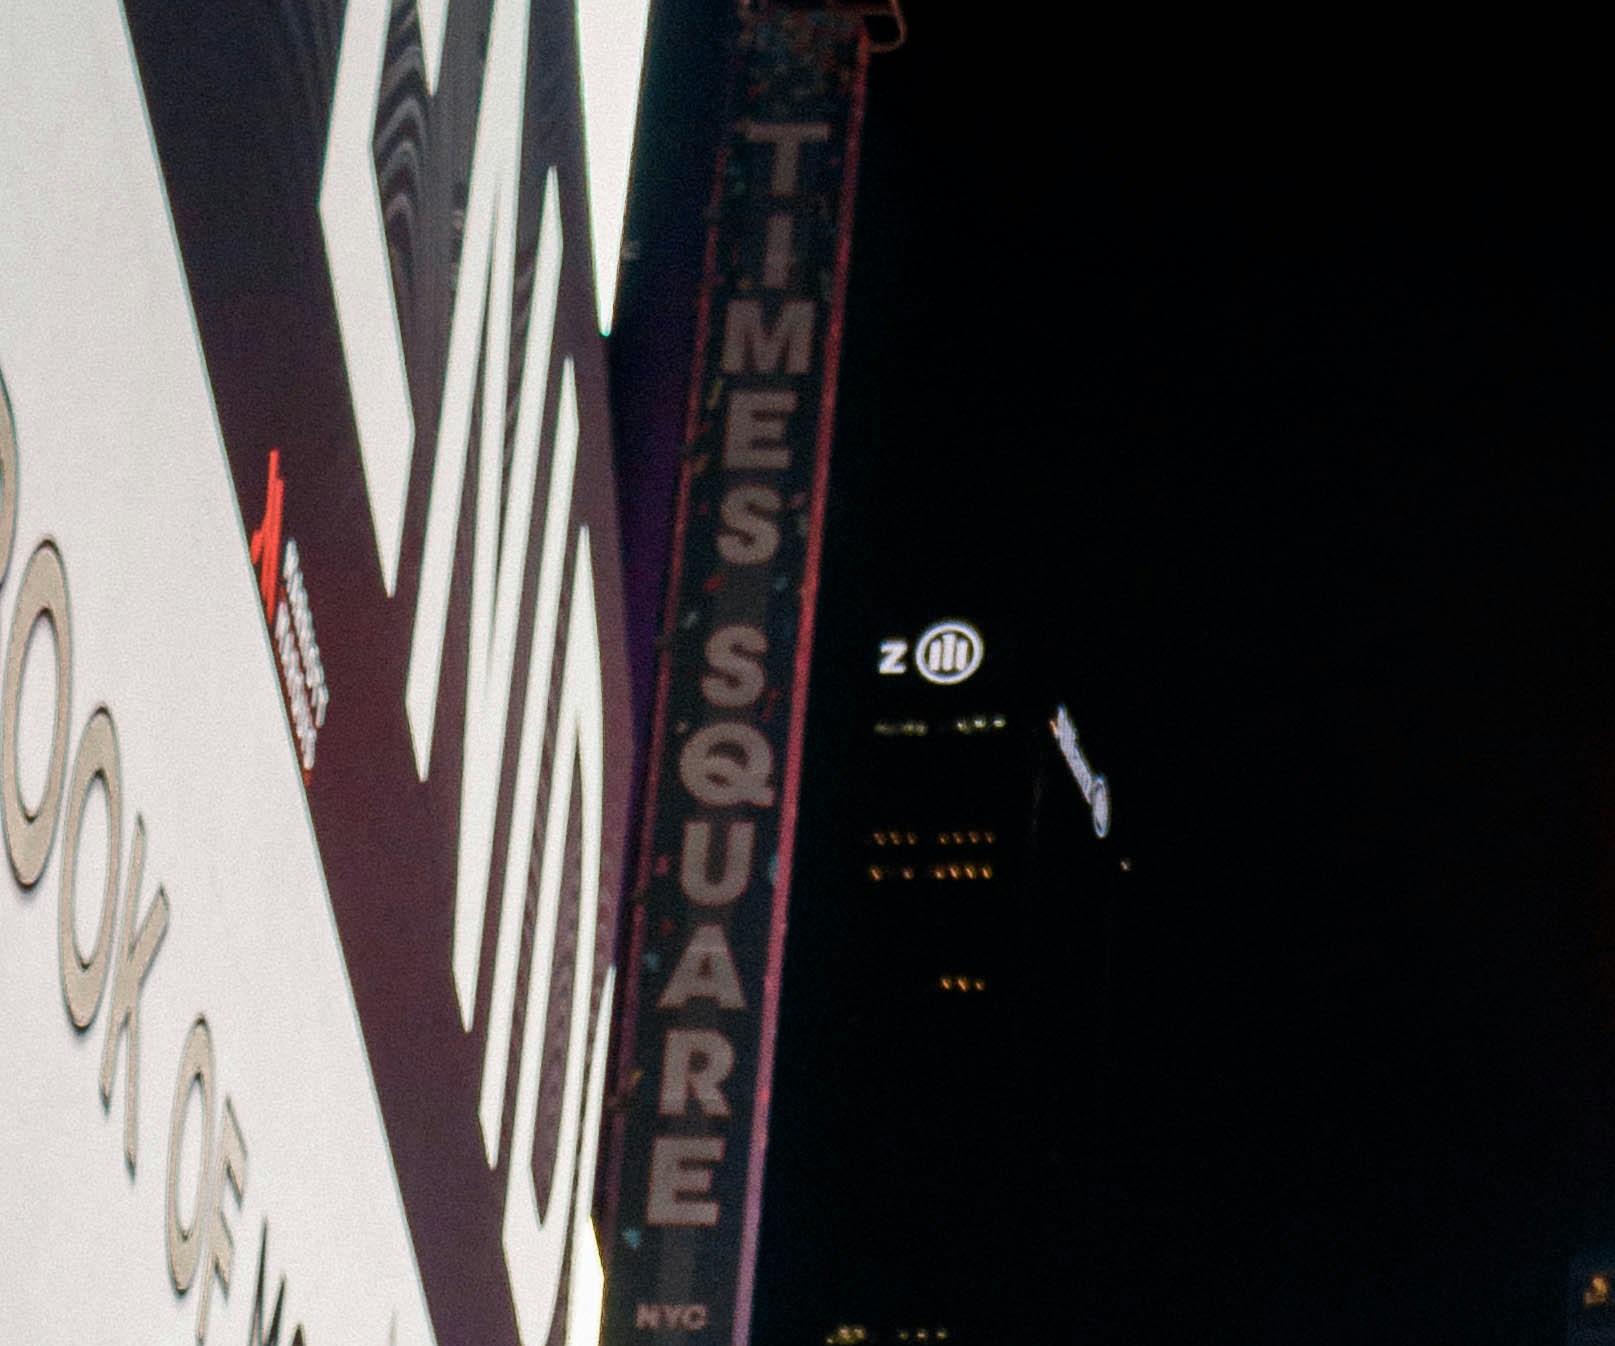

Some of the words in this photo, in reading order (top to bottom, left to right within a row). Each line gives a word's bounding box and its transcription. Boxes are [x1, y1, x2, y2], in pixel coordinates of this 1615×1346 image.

[716, 121, 831, 567] TIMES
[0, 365, 171, 1184] OOK
[646, 624, 774, 1227] SQUARE
[635, 1303, 710, 1331] NYC
